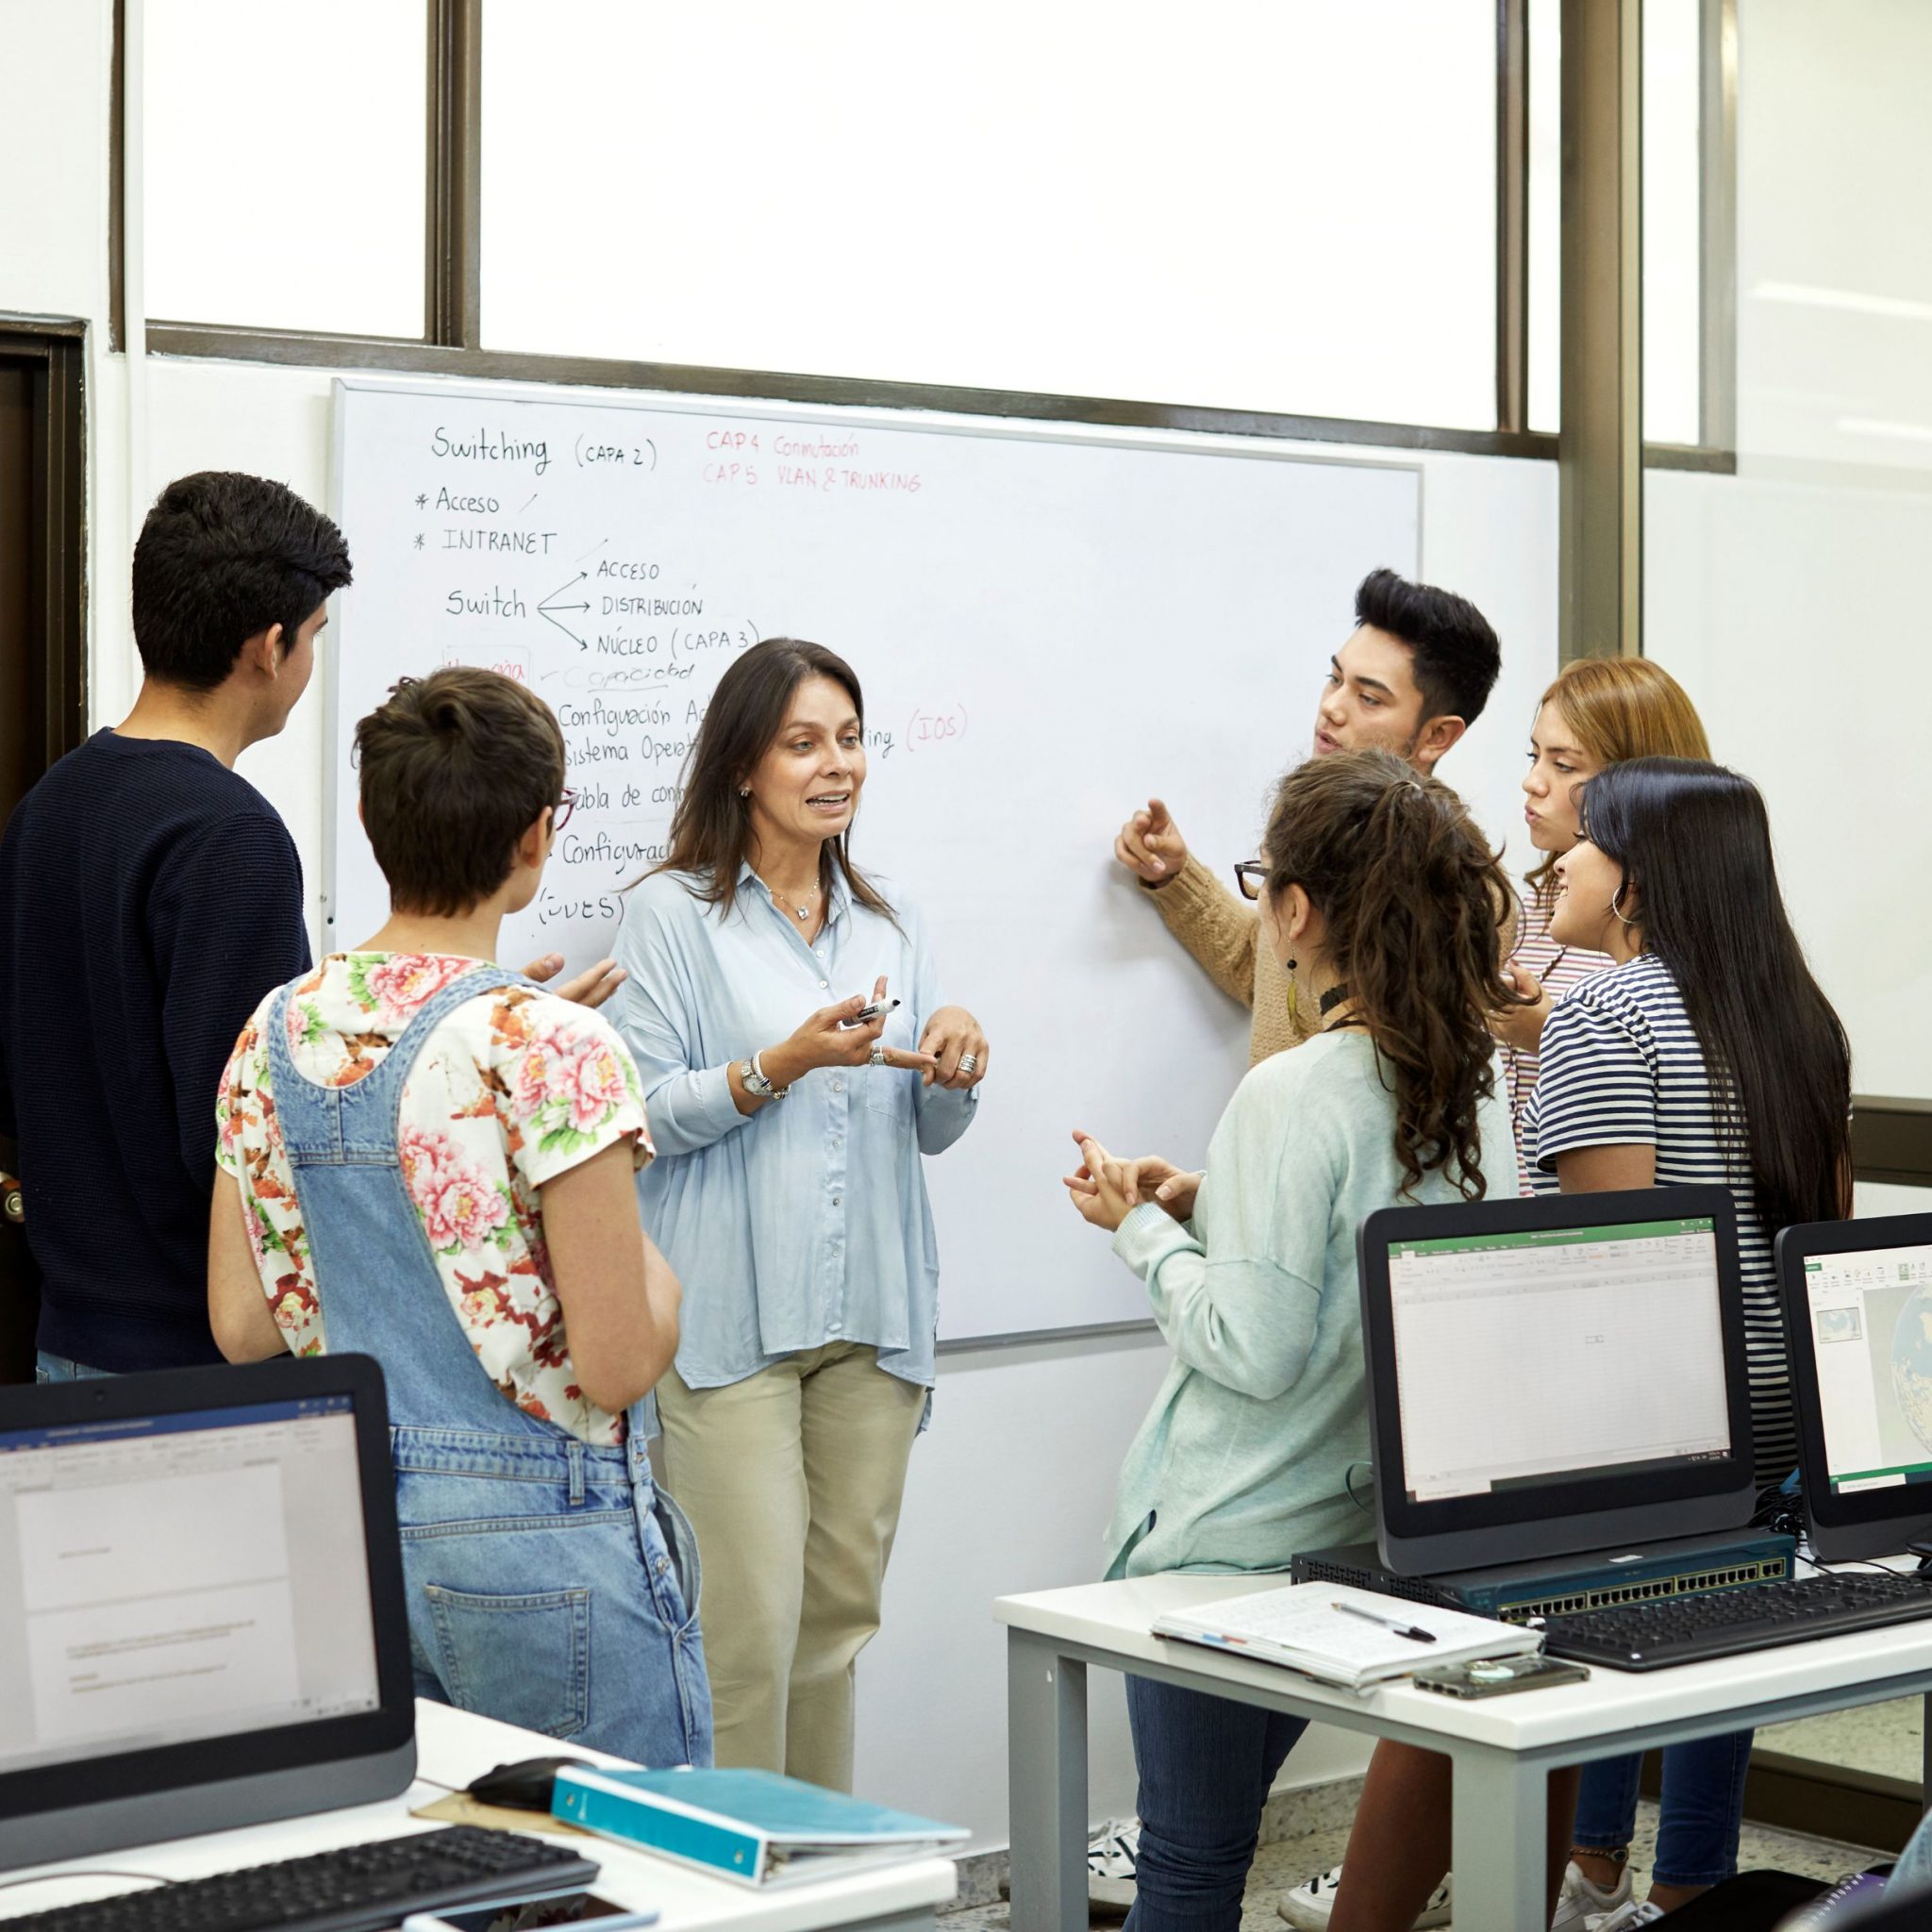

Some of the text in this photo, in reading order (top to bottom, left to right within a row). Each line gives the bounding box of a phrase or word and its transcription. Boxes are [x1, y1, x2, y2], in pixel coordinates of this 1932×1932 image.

[431, 426, 552, 476] Switching
[777, 465, 817, 488] VLAN
[822, 467, 837, 491] &
[841, 470, 922, 493] TRUNKING
[436, 487, 500, 513] Acceso
[441, 528, 558, 555] INTRANET
[596, 559, 660, 580] ACCESO
[446, 585, 526, 619] Switch
[602, 583, 704, 616] DISTRIBUCIÓN
[596, 625, 658, 657] NÚCLEO
[563, 662, 695, 689] Capacidad
[565, 736, 629, 766] Sistema
[641, 732, 698, 766] Operat
[906, 702, 968, 753] (IOS)
[622, 783, 641, 808] de
[562, 831, 668, 875] Configurac
